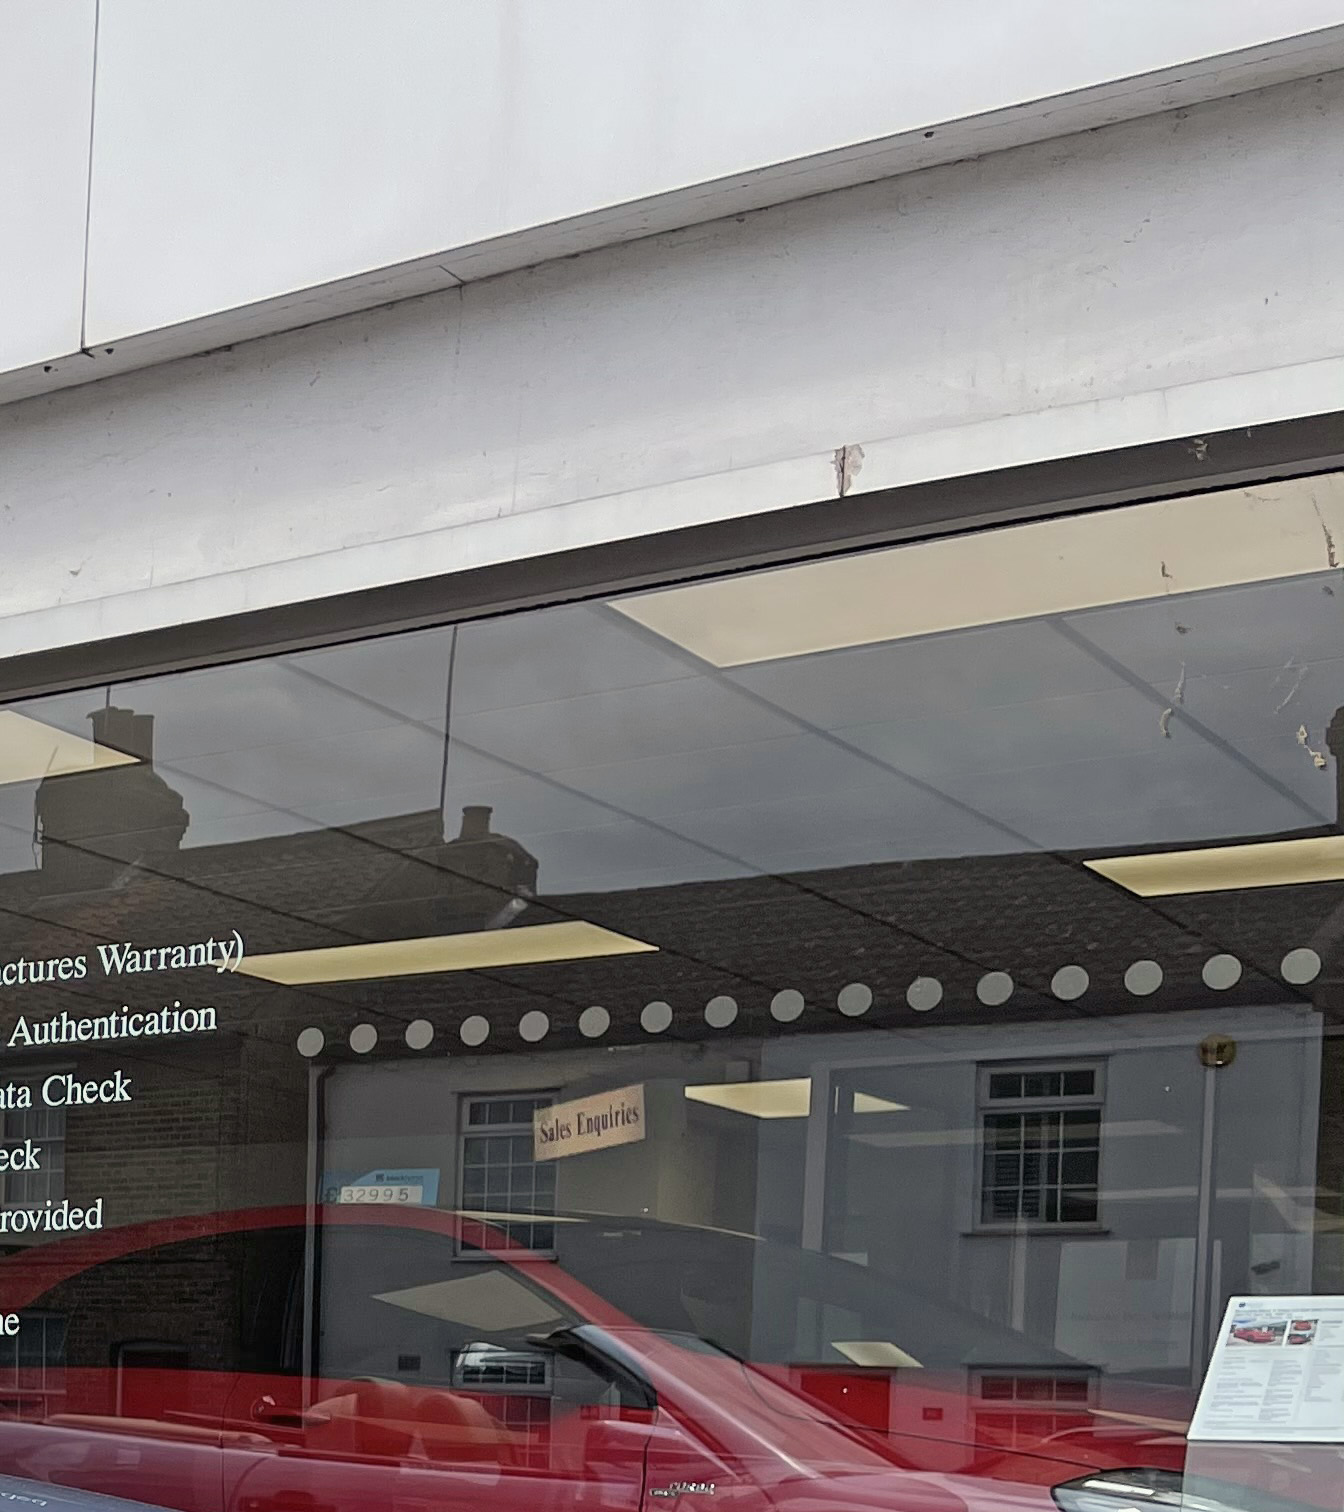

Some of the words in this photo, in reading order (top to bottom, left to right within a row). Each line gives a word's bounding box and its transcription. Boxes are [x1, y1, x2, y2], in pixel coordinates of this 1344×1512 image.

[97, 929, 245, 976] Warranty)
[7, 1001, 217, 1050] Authentication
[42, 1070, 133, 1107] Check
[540, 1117, 572, 1144] Sales
[576, 1102, 639, 1138] Enquiries
